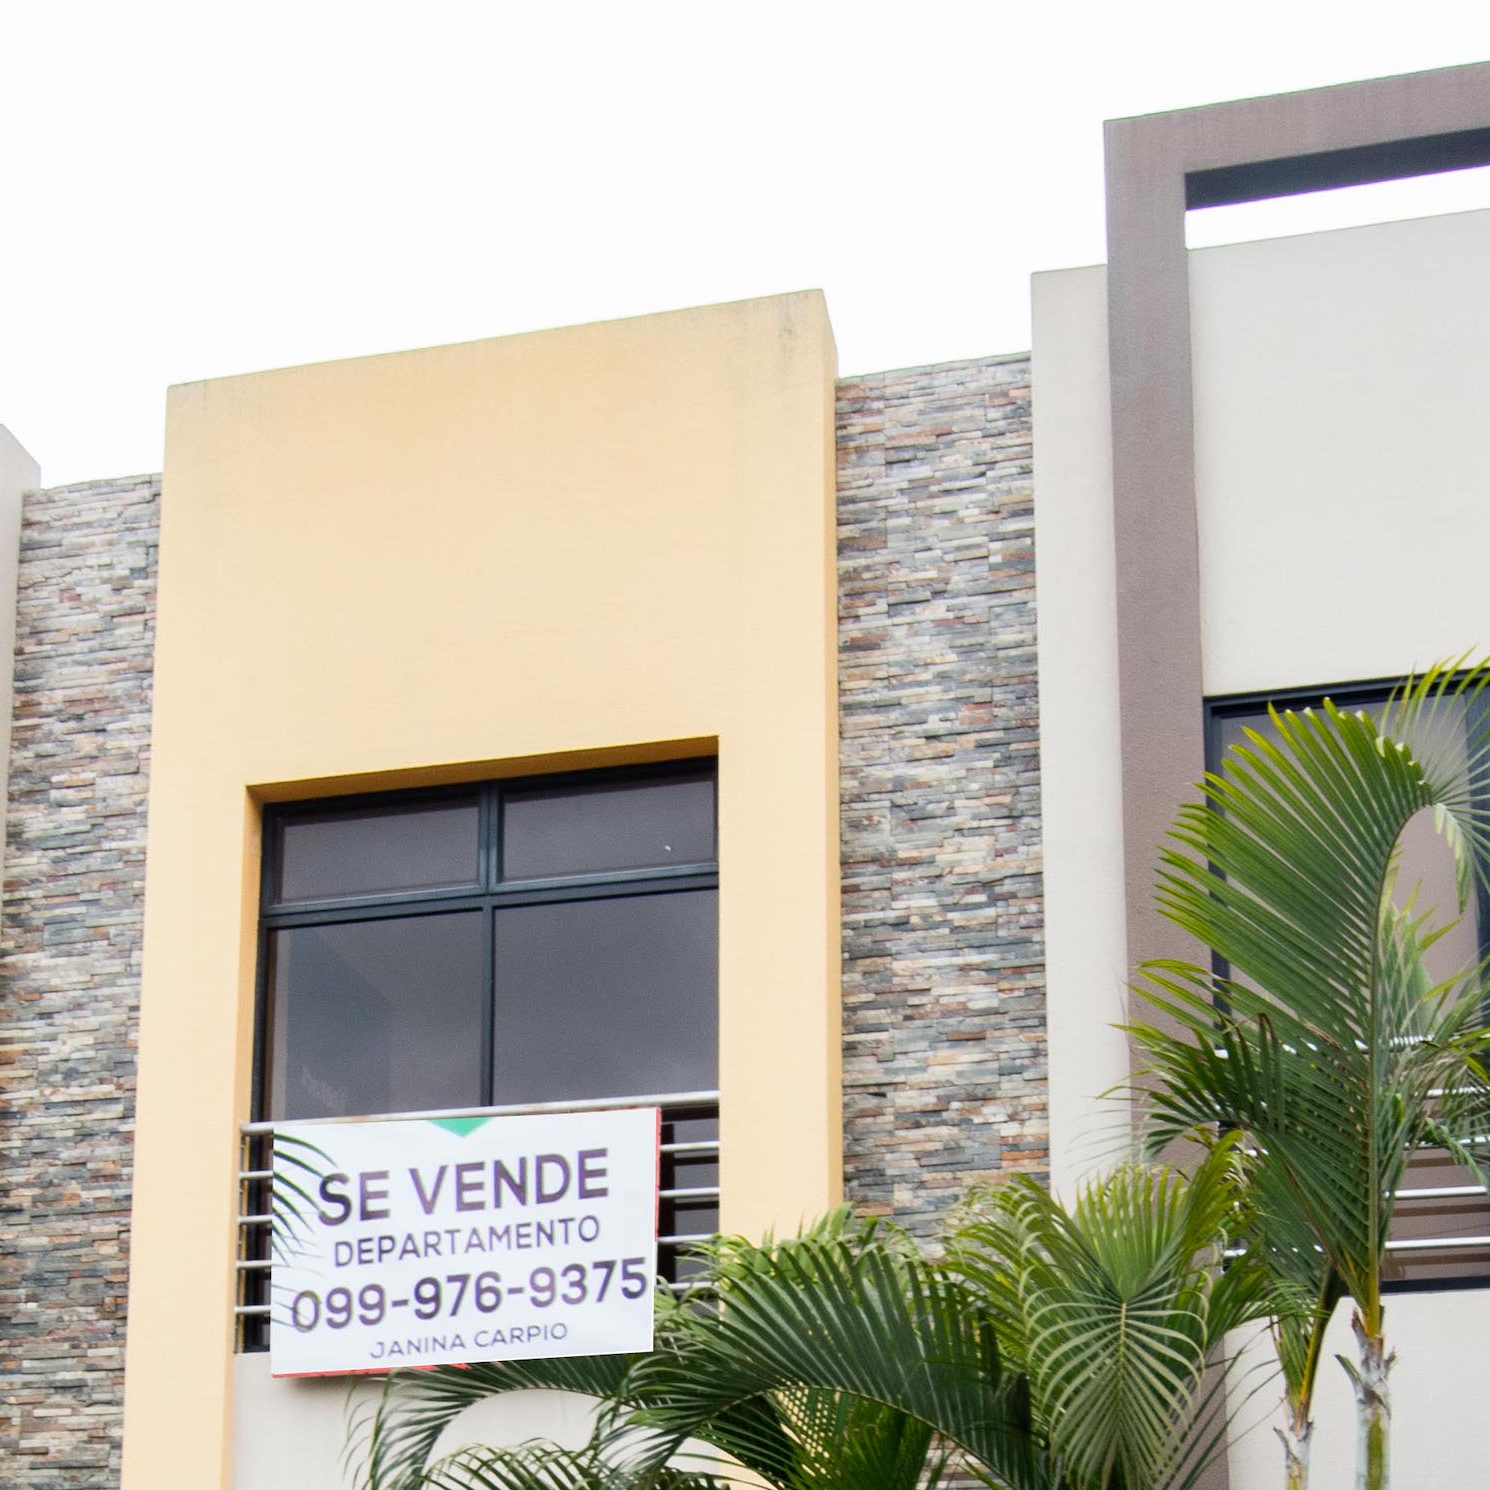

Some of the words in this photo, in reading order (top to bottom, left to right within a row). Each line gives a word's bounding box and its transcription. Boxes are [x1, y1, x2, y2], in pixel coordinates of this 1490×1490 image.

[318, 1170, 389, 1226] SE
[409, 1148, 608, 1215] VENDE
[334, 1215, 599, 1266] DEPARTAMENTO
[292, 1258, 645, 1332] 099-976-9375
[370, 1335, 465, 1358] JANINA
[475, 1323, 567, 1347] CARPIO
